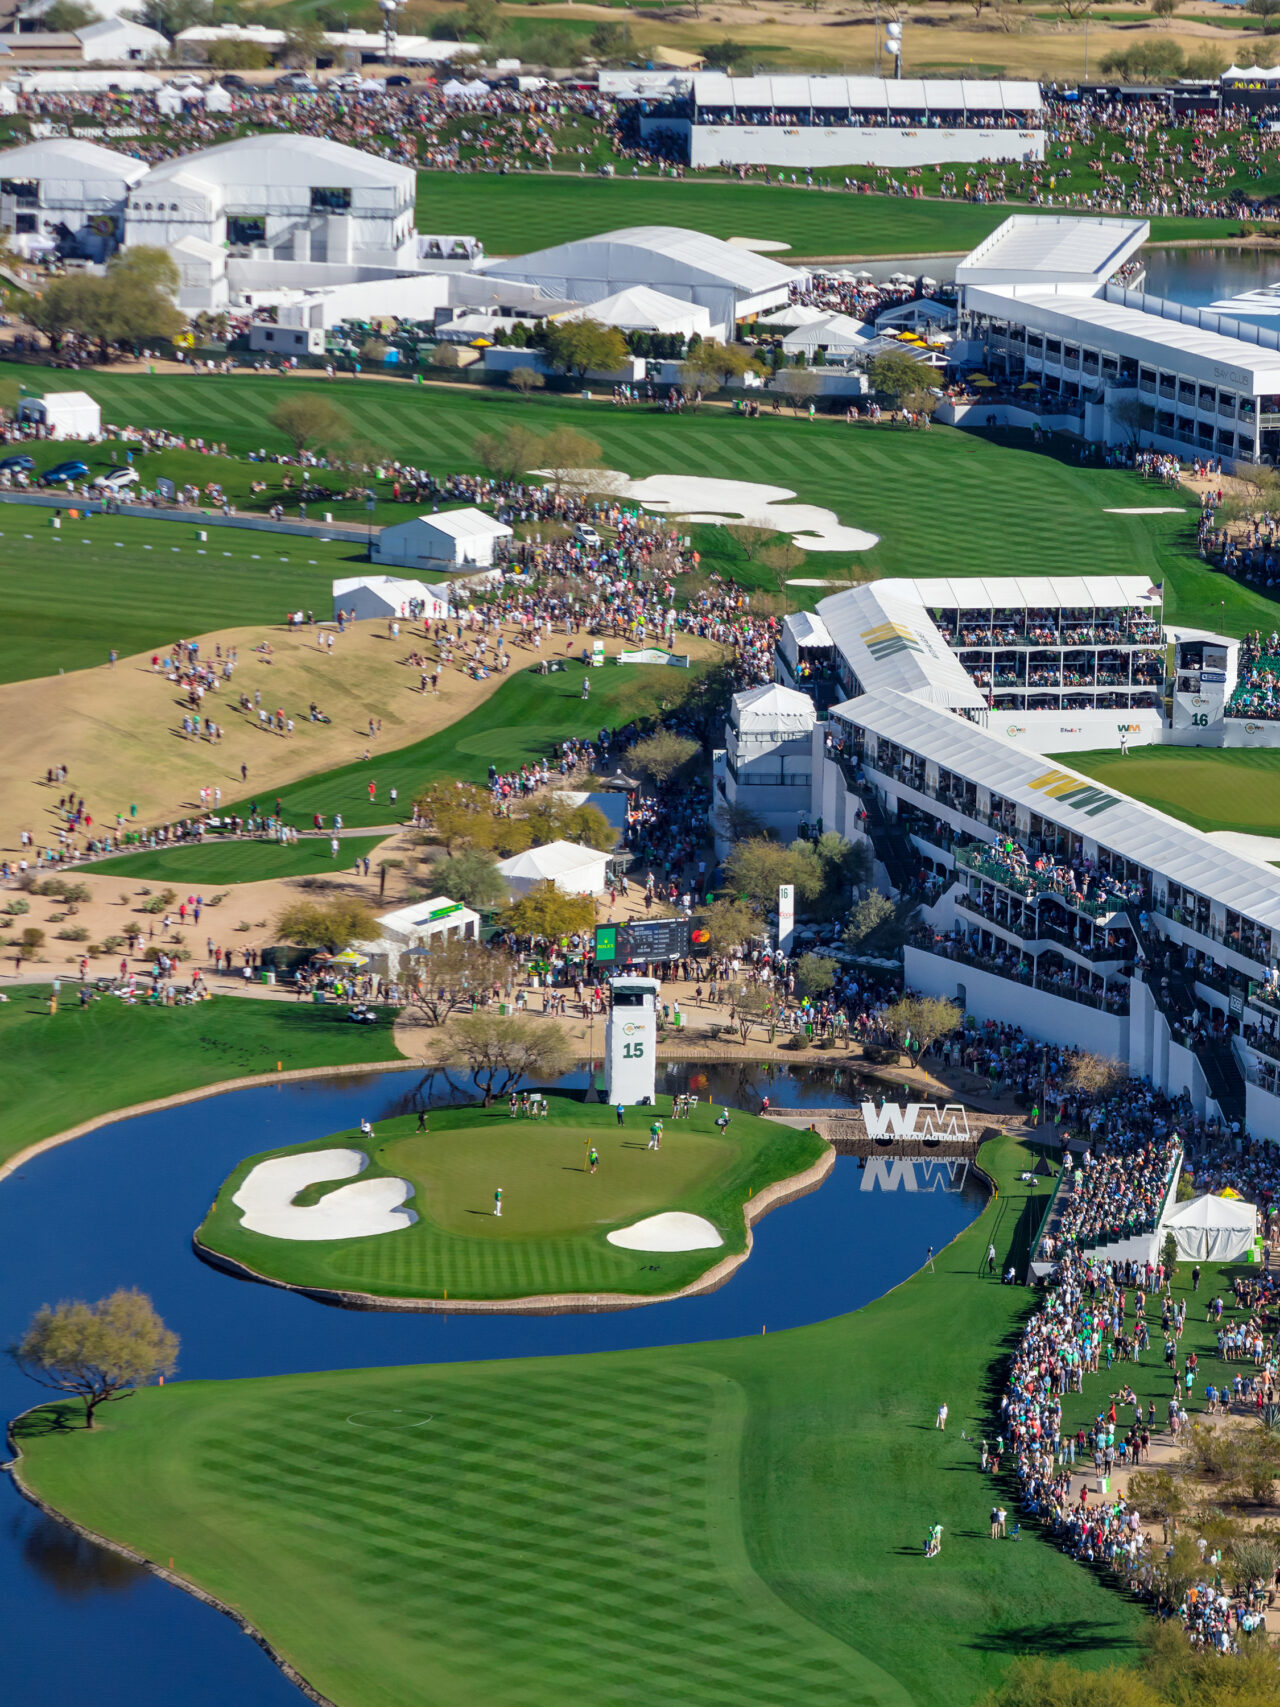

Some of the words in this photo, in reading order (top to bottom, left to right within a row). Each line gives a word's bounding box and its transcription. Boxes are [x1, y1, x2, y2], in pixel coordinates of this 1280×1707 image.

[72, 127, 105, 138] THINK
[1230, 371, 1249, 385] CLUB
[1191, 712, 1208, 726] 16
[1117, 724, 1141, 732] WM
[781, 888, 788, 899] 16
[622, 1042, 644, 1059] 15
[861, 1103, 970, 1137] WM
